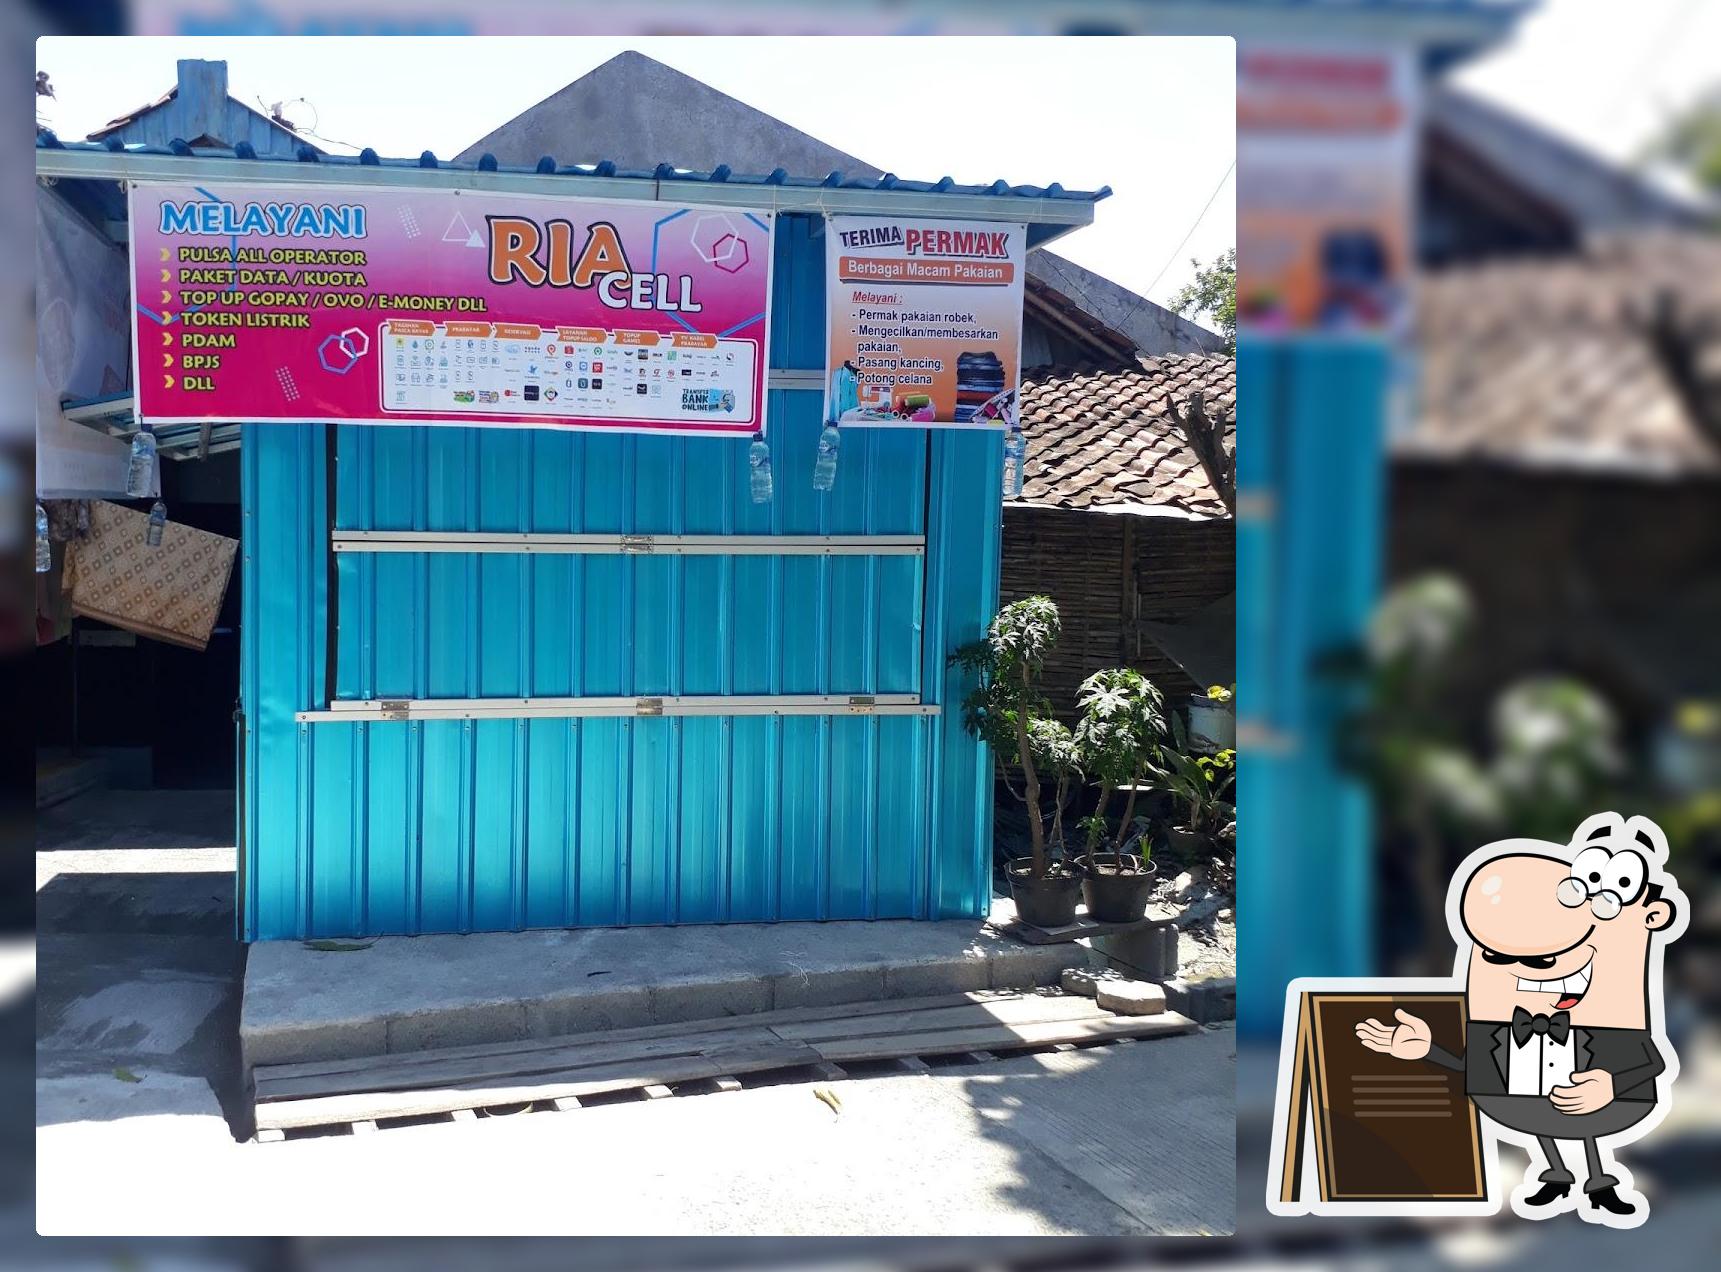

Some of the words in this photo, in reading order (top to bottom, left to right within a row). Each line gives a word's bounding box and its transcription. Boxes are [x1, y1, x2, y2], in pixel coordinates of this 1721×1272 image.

[159, 200, 367, 238] MELAYANI
[840, 225, 903, 248] TERIMA
[905, 229, 1009, 258] PERMAK
[179, 247, 232, 263] PULSA
[234, 248, 268, 264] ALL
[269, 249, 367, 265] OPERATOR
[485, 215, 632, 289] RIA
[179, 269, 235, 284] PAKET
[240, 270, 290, 285] DATA
[303, 271, 367, 286] KUOTA
[848, 260, 903, 277] Berbagai
[907, 262, 950, 277] Macam
[954, 264, 1003, 279] Pakaian
[598, 271, 702, 312] CELL
[852, 291, 897, 304] Melayani
[180, 291, 218, 305] TOP
[220, 292, 242, 306] UP
[248, 292, 309, 307] GOPAY
[323, 293, 364, 308] OVO
[378, 295, 454, 311] E-MONEY
[457, 298, 487, 312] DLL
[181, 312, 242, 327] TOKEN
[246, 313, 310, 328] LISTRIK
[859, 308, 898, 321] Permak
[901, 310, 941, 323] pakaian
[944, 312, 977, 324] robek,
[858, 324, 999, 340] Mengecilkan/membesarkan
[182, 334, 236, 349] PDAM
[857, 340, 902, 354] pakaian,
[182, 355, 220, 370] BPJS
[858, 356, 897, 371] Pasang
[183, 377, 215, 391] DLL
[857, 372, 895, 386] Potong
[898, 374, 932, 384] celana
[682, 394, 709, 403] BANK
[681, 403, 709, 411] ONLINE
